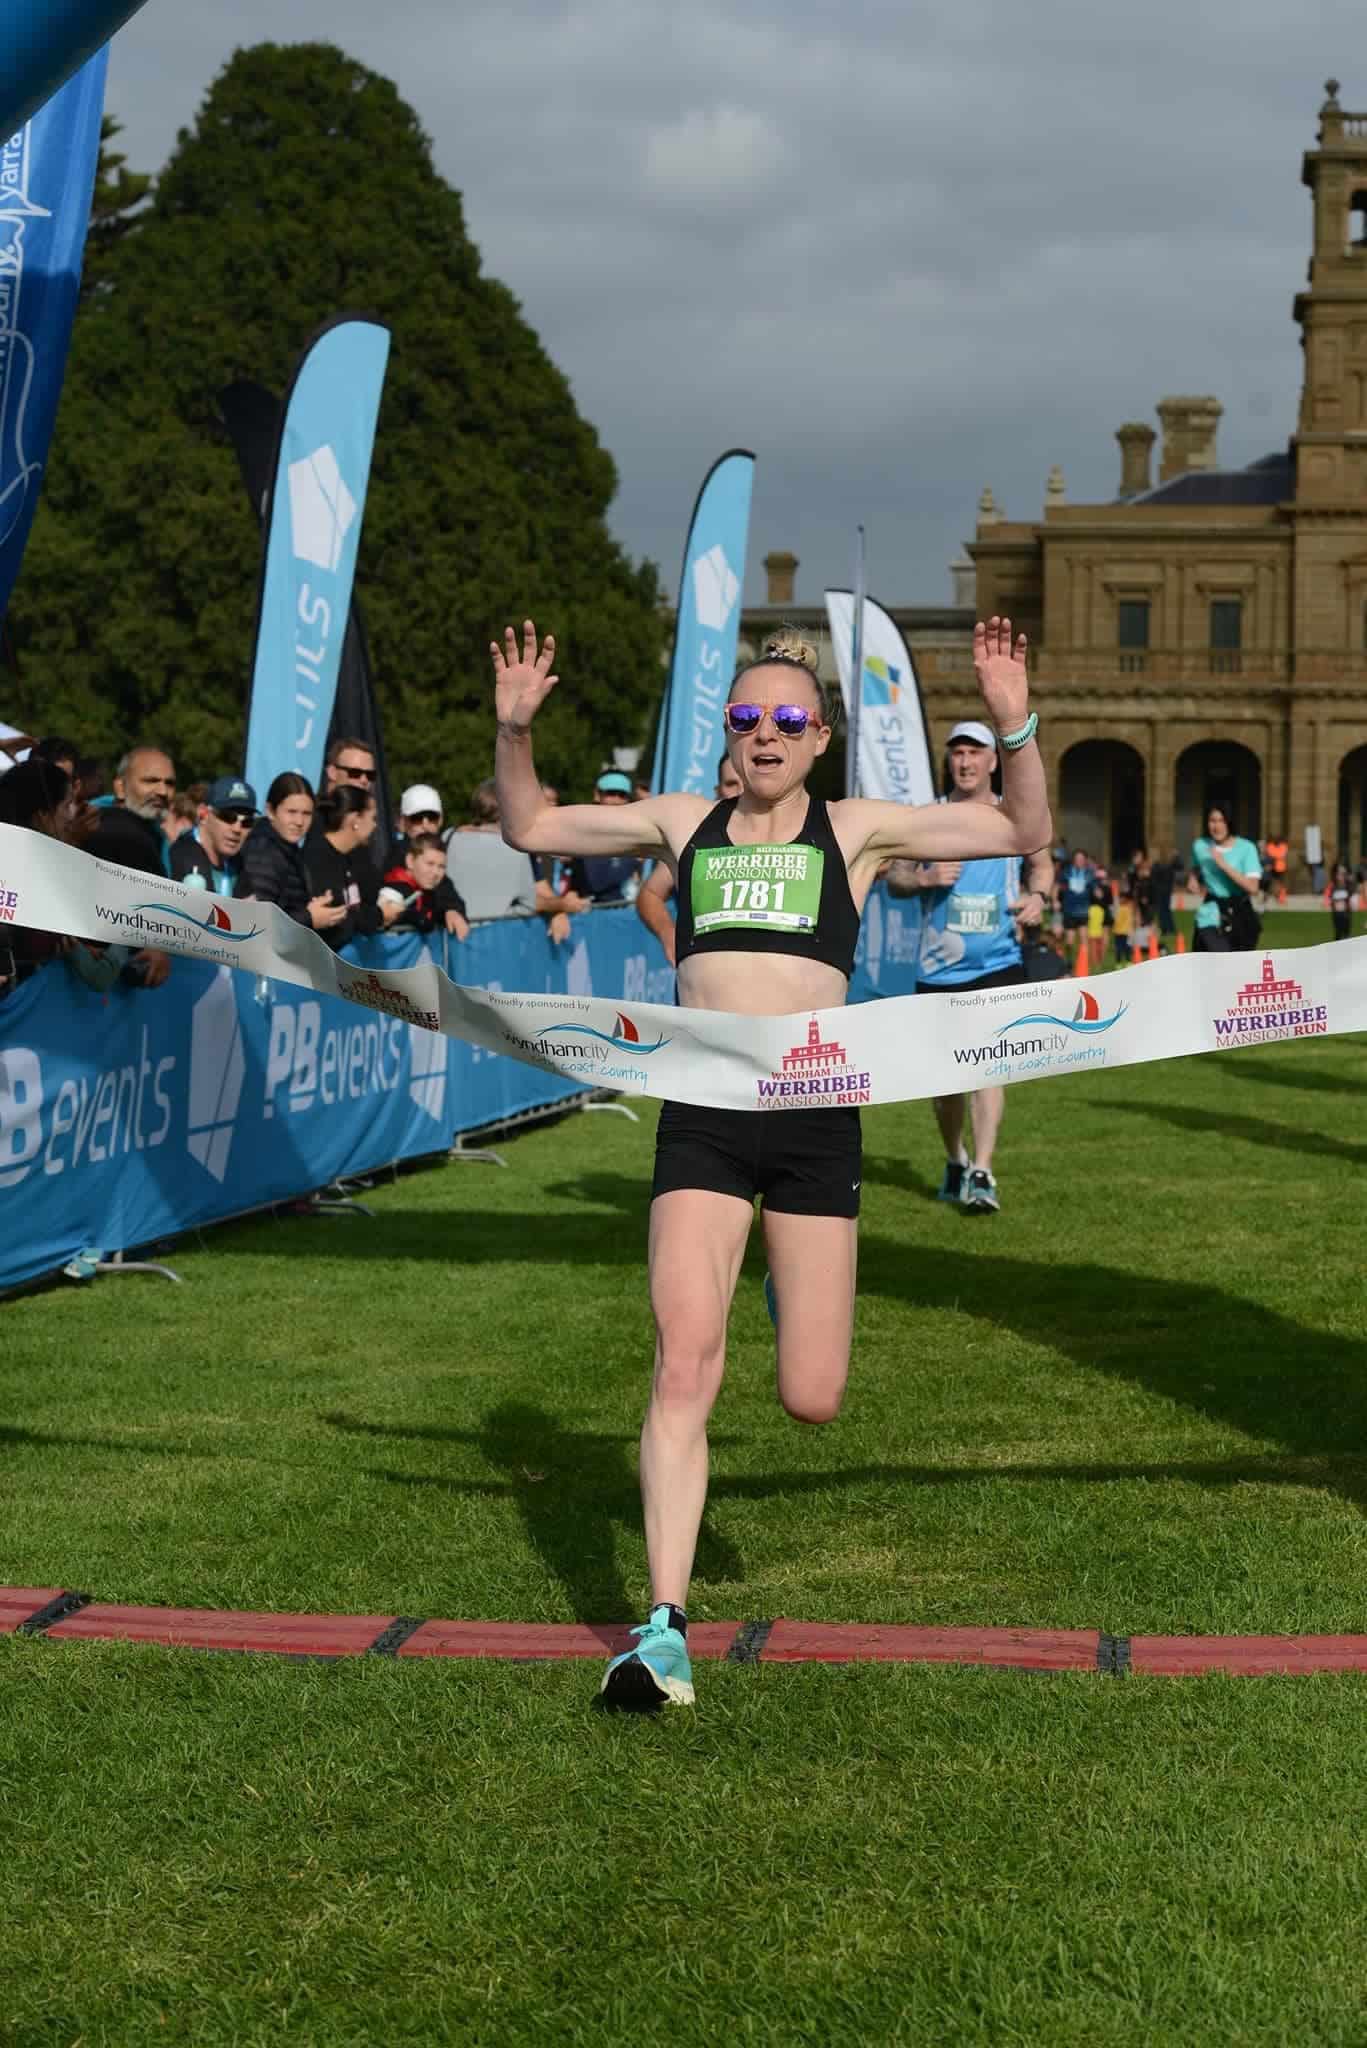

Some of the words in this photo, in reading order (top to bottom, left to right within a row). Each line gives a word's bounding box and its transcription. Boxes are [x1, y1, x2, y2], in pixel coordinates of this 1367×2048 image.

[708, 854, 808, 871] WERRIBEE
[706, 867, 771, 881] MANSION
[774, 868, 807, 881] RUN
[176, 886, 188, 898] by
[720, 880, 785, 911] 1781
[525, 999, 576, 1011] sponsored
[577, 1001, 590, 1012] by
[950, 994, 987, 1008] Proudly
[988, 989, 1039, 1007] sponsored
[1040, 986, 1054, 999] by
[1227, 1003, 1287, 1017] WYNDHAM
[1288, 998, 1313, 1010] CITY
[1213, 1005, 1328, 1035] WERRIBEE
[1216, 1028, 1289, 1049] MANSION
[1294, 1021, 1328, 1036] RUN
[771, 1068, 831, 1081] WYNDHAM
[832, 1063, 857, 1074] CITY
[757, 1072, 872, 1097] WERRIBEE
[44, 1023, 177, 1176] events
[756, 1094, 832, 1109] MANSION
[836, 1090, 871, 1105] RUN
